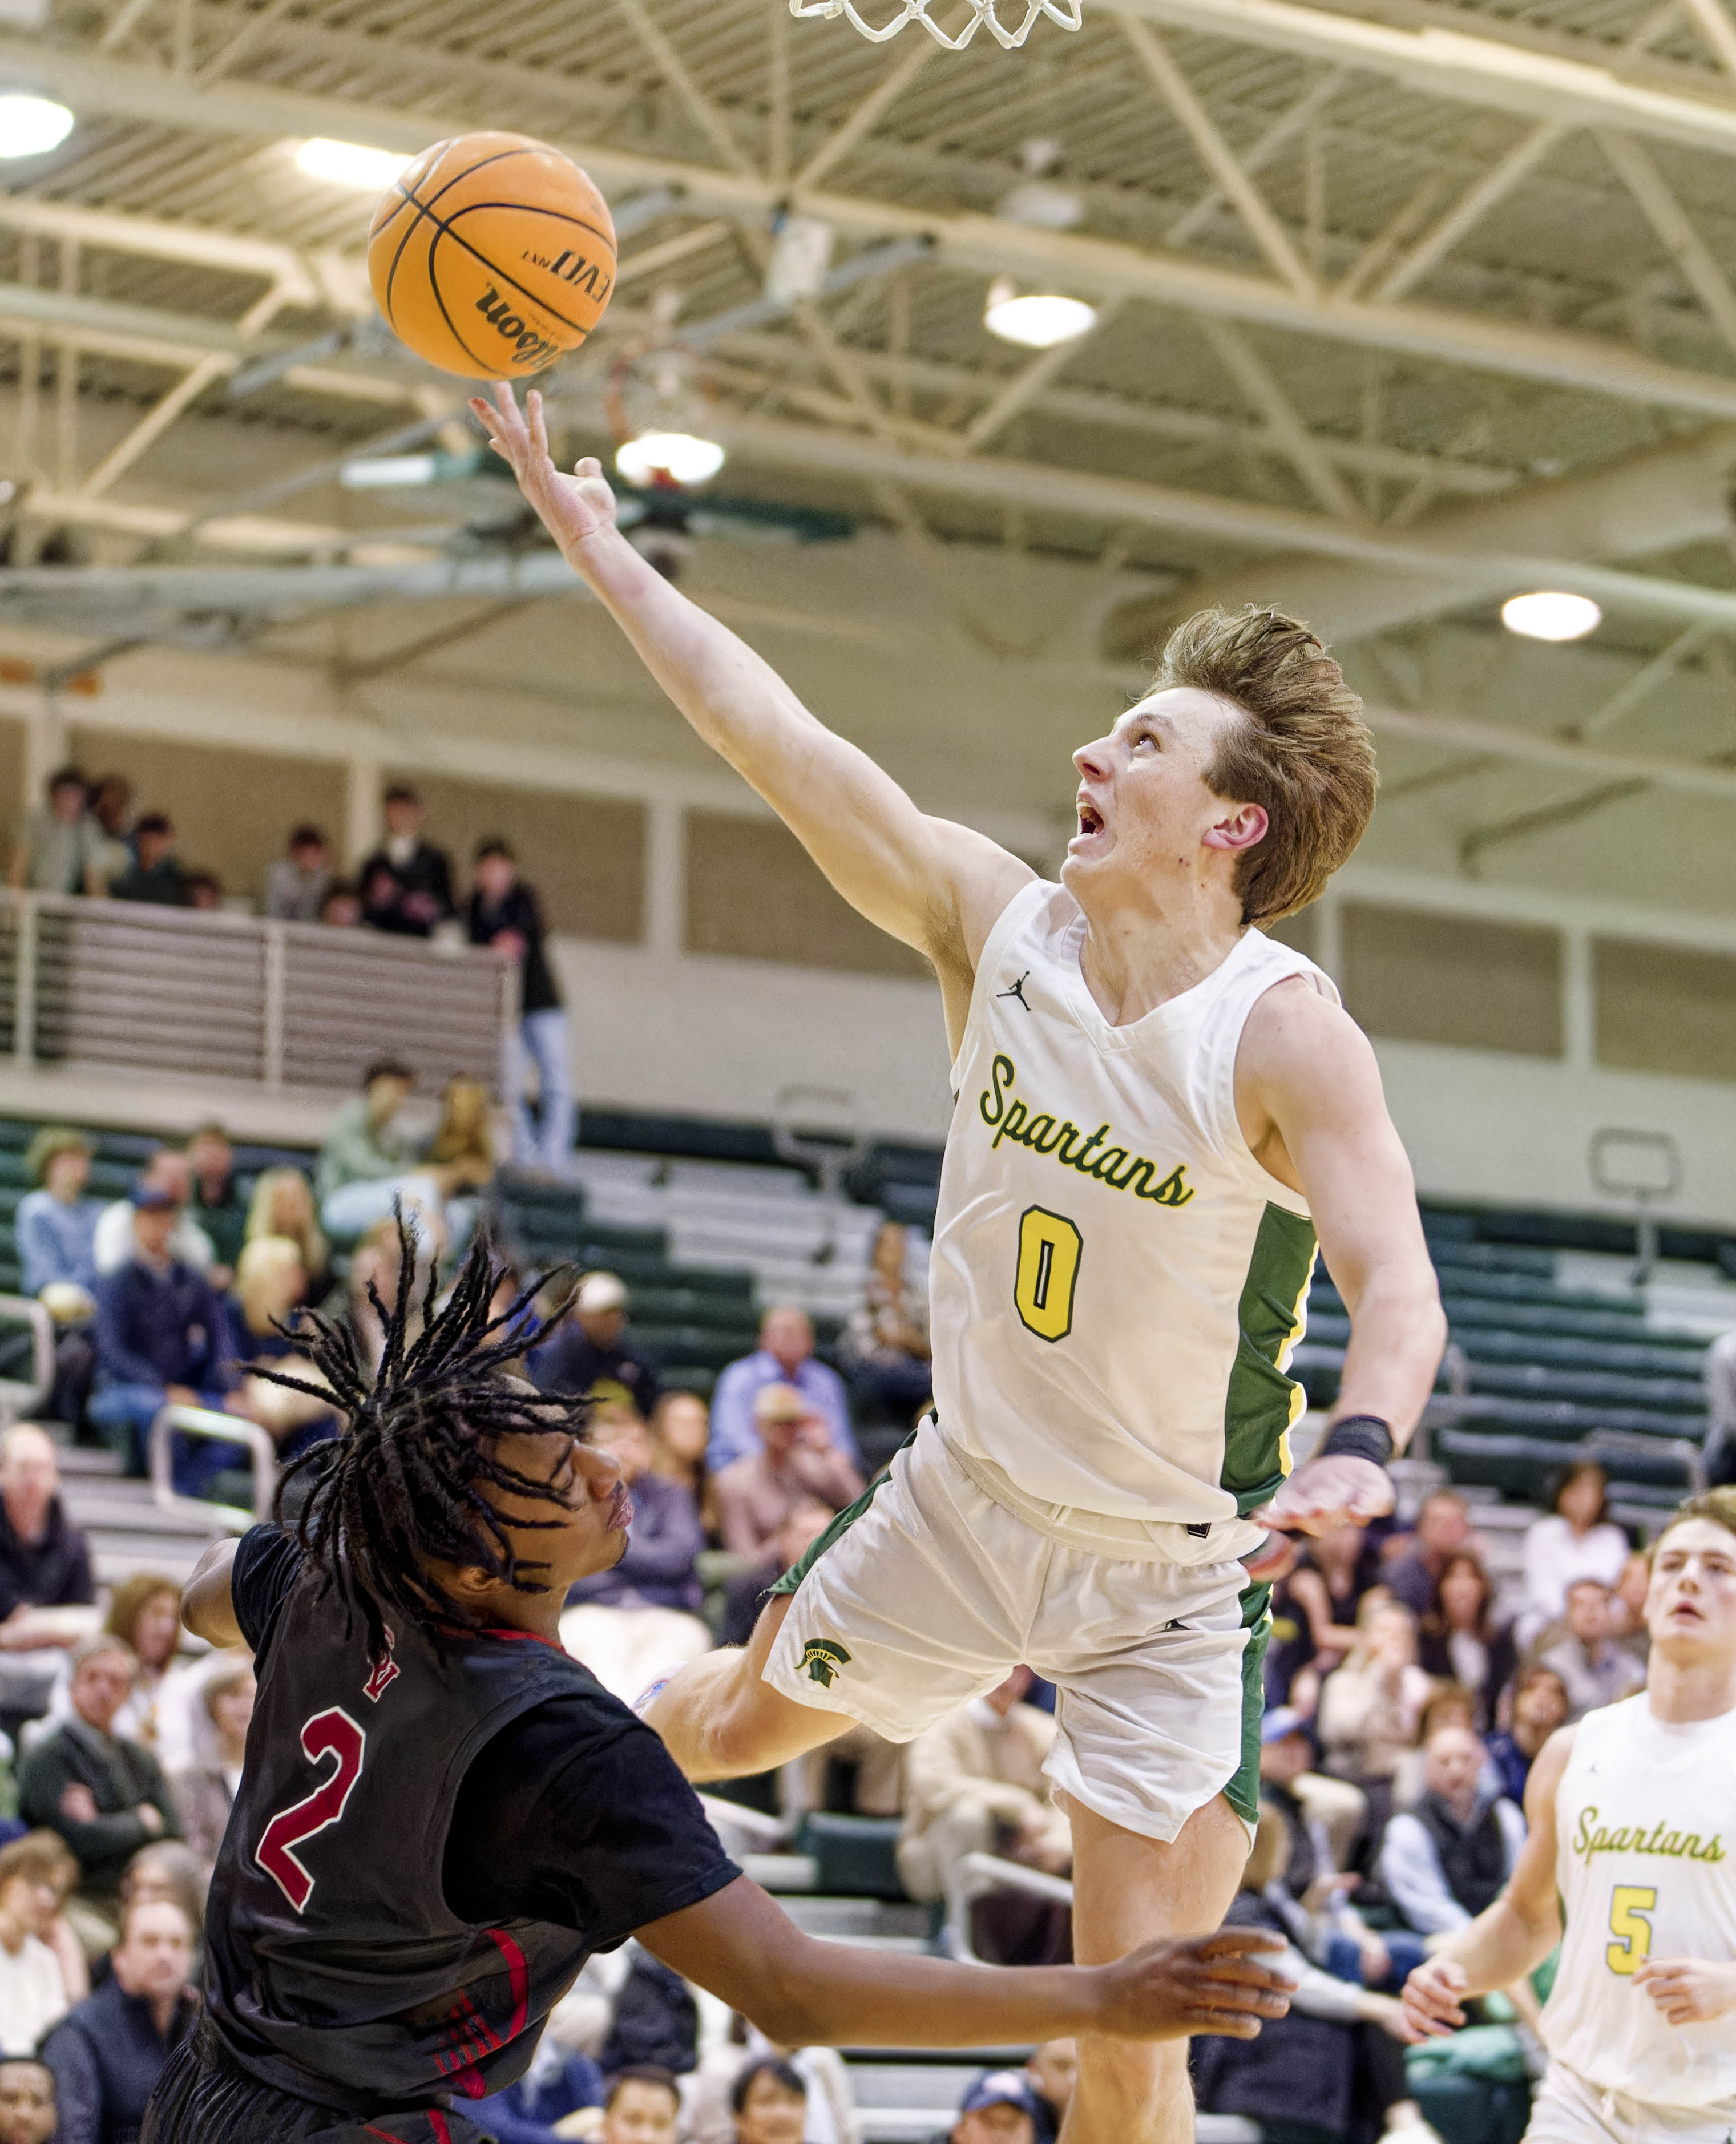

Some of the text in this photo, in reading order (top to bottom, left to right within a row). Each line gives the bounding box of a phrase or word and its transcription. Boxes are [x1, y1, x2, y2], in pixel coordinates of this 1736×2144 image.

[551, 250, 611, 302] EVO
[476, 288, 559, 368] ilson
[980, 1054, 1194, 1207] Spartans
[1015, 1205, 1083, 1343] 0
[256, 1706, 366, 1914] 2
[1574, 1806, 1725, 1866] Spartans
[1607, 1885, 1657, 1975] 5
